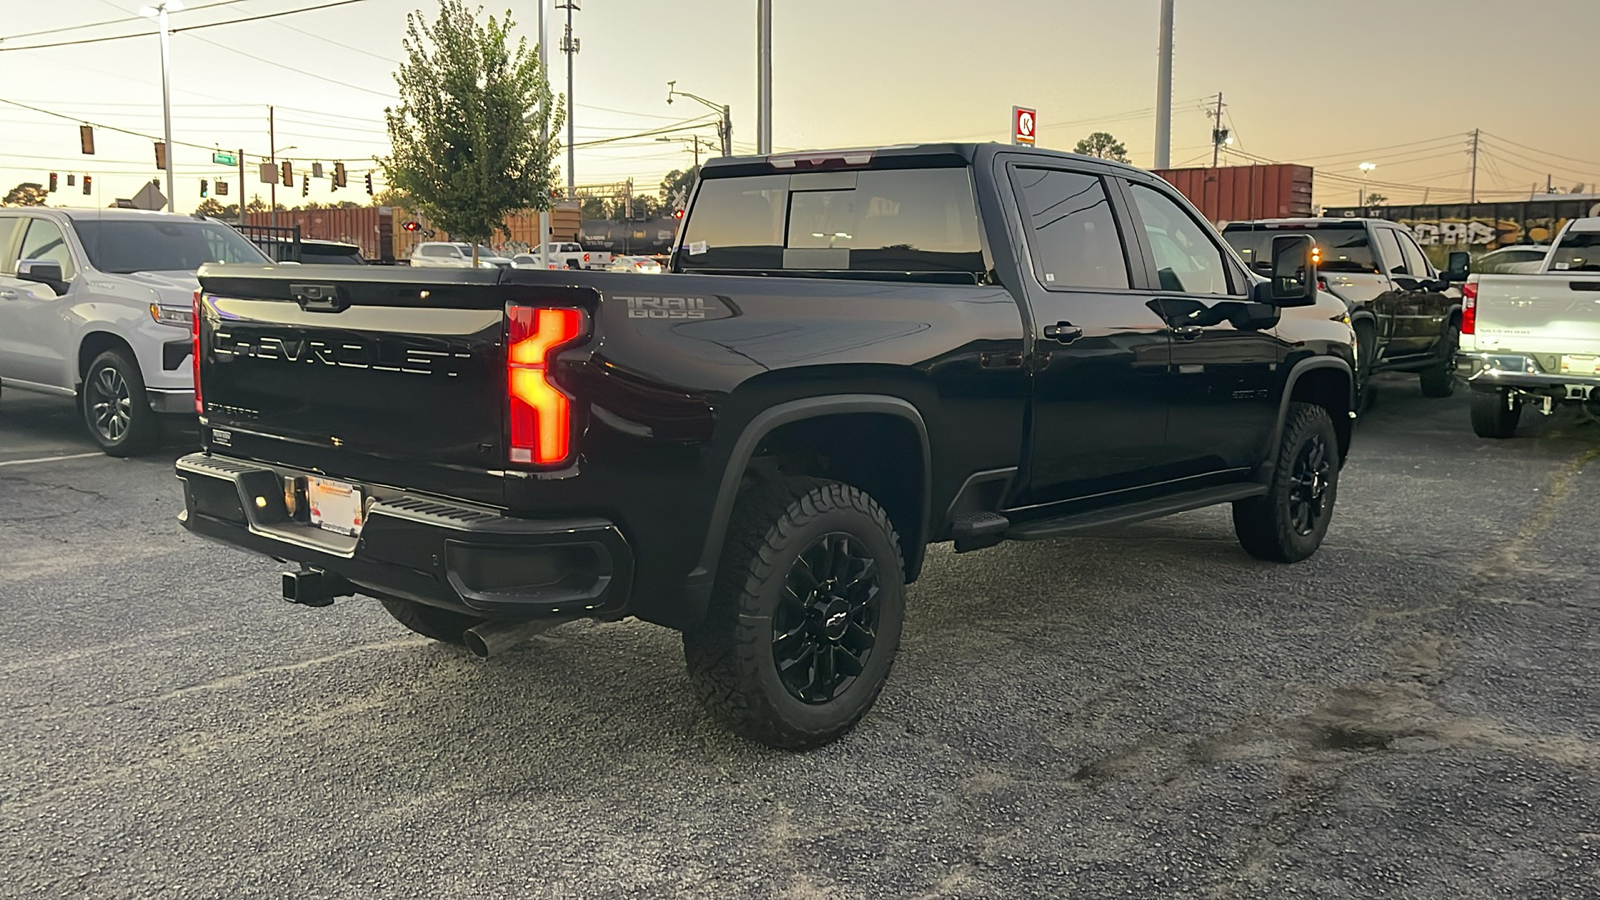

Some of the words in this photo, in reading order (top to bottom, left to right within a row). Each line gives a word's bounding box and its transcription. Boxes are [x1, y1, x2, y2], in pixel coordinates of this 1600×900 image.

[612, 296, 717, 310] TRAIL
[628, 308, 705, 319] BOSS
[212, 332, 471, 378] CHEVROLET
